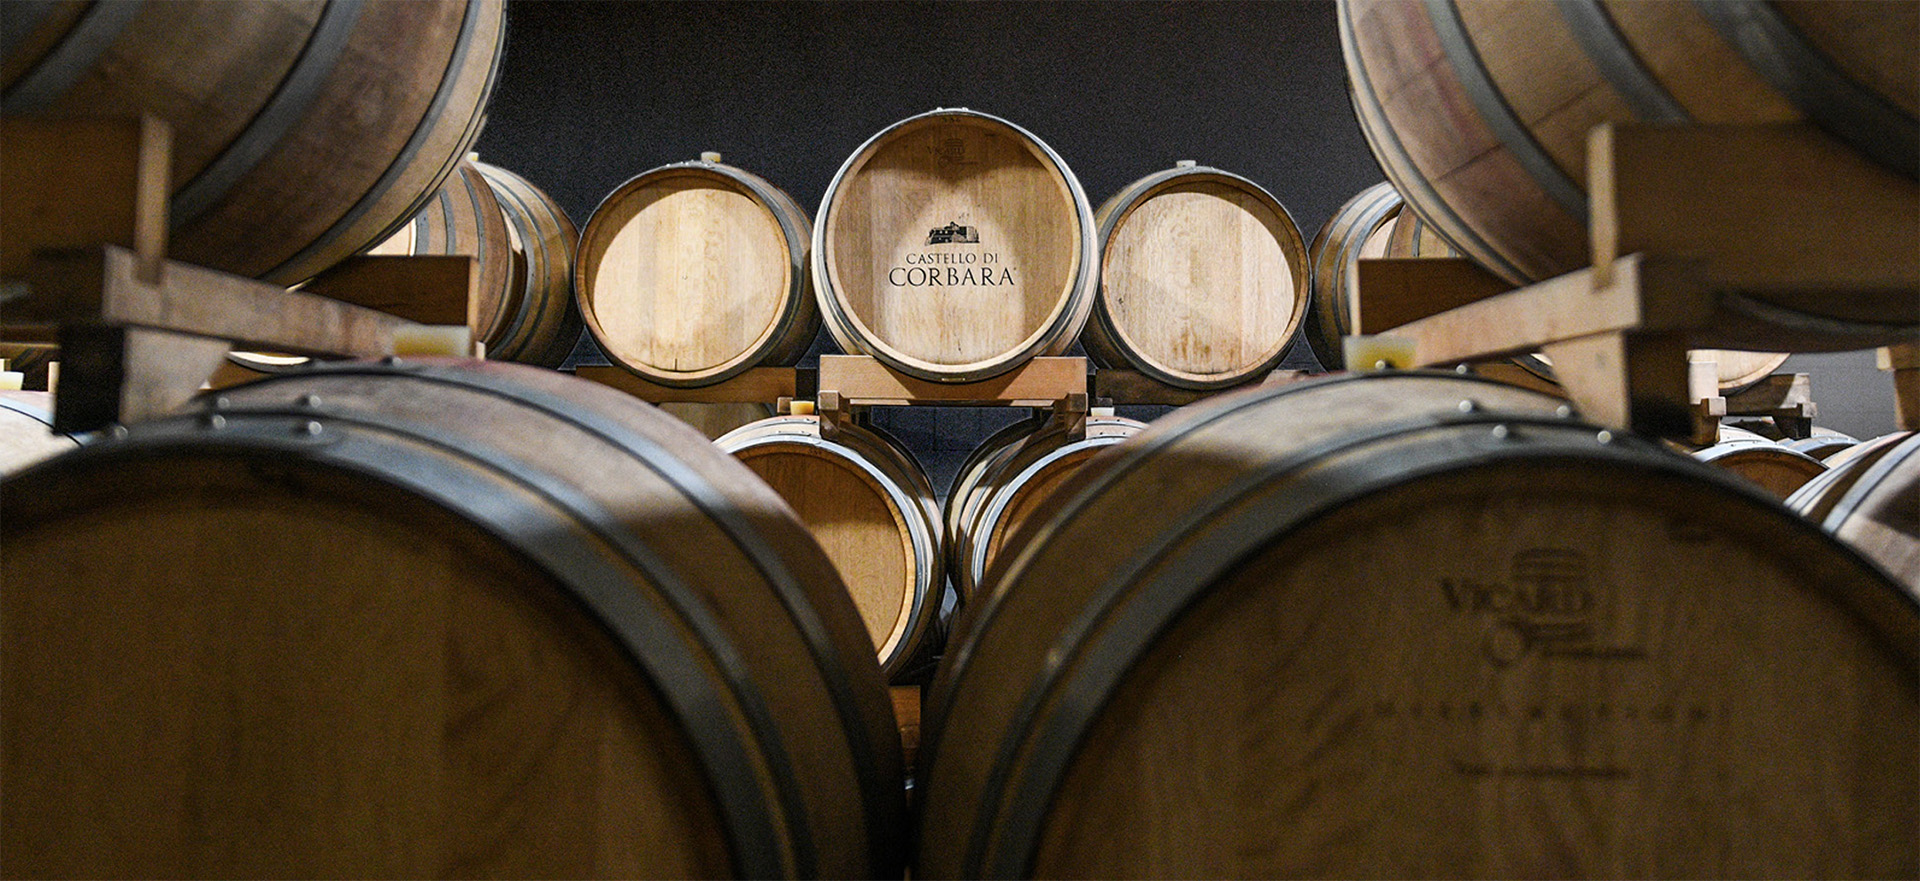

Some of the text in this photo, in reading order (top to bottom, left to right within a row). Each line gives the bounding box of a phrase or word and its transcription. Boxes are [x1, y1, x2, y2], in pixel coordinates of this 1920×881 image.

[905, 252, 998, 265] CASTELLO DI
[888, 266, 1015, 287] CORBARA
